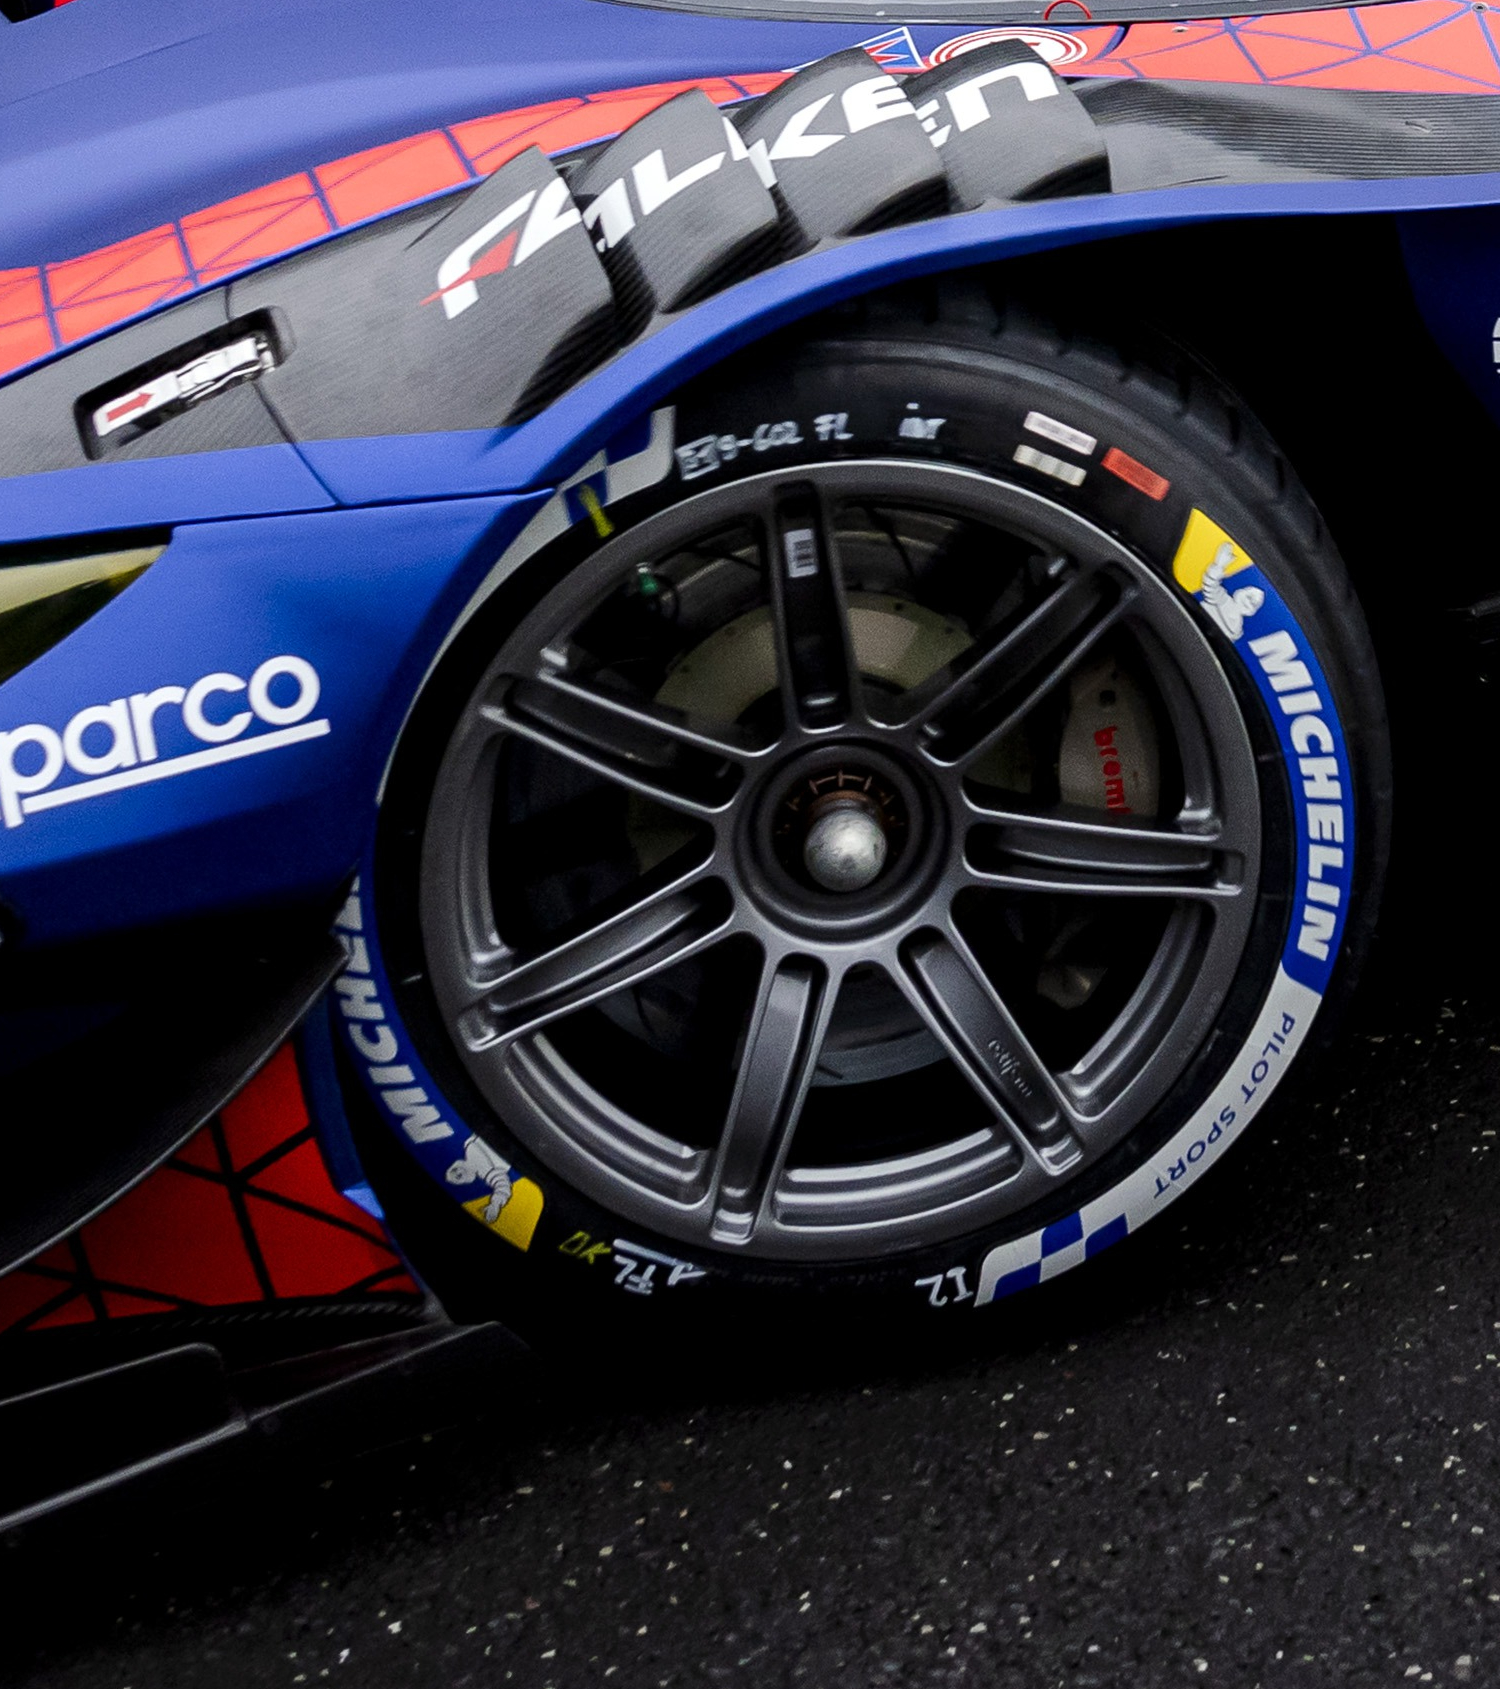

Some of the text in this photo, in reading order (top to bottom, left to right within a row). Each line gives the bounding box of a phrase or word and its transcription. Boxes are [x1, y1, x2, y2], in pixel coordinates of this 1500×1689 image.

[418, 58, 1063, 320] FALKEN
[1246, 631, 1350, 963] MICHELIN
[1152, 1009, 1299, 1201] PILOT SPORT
